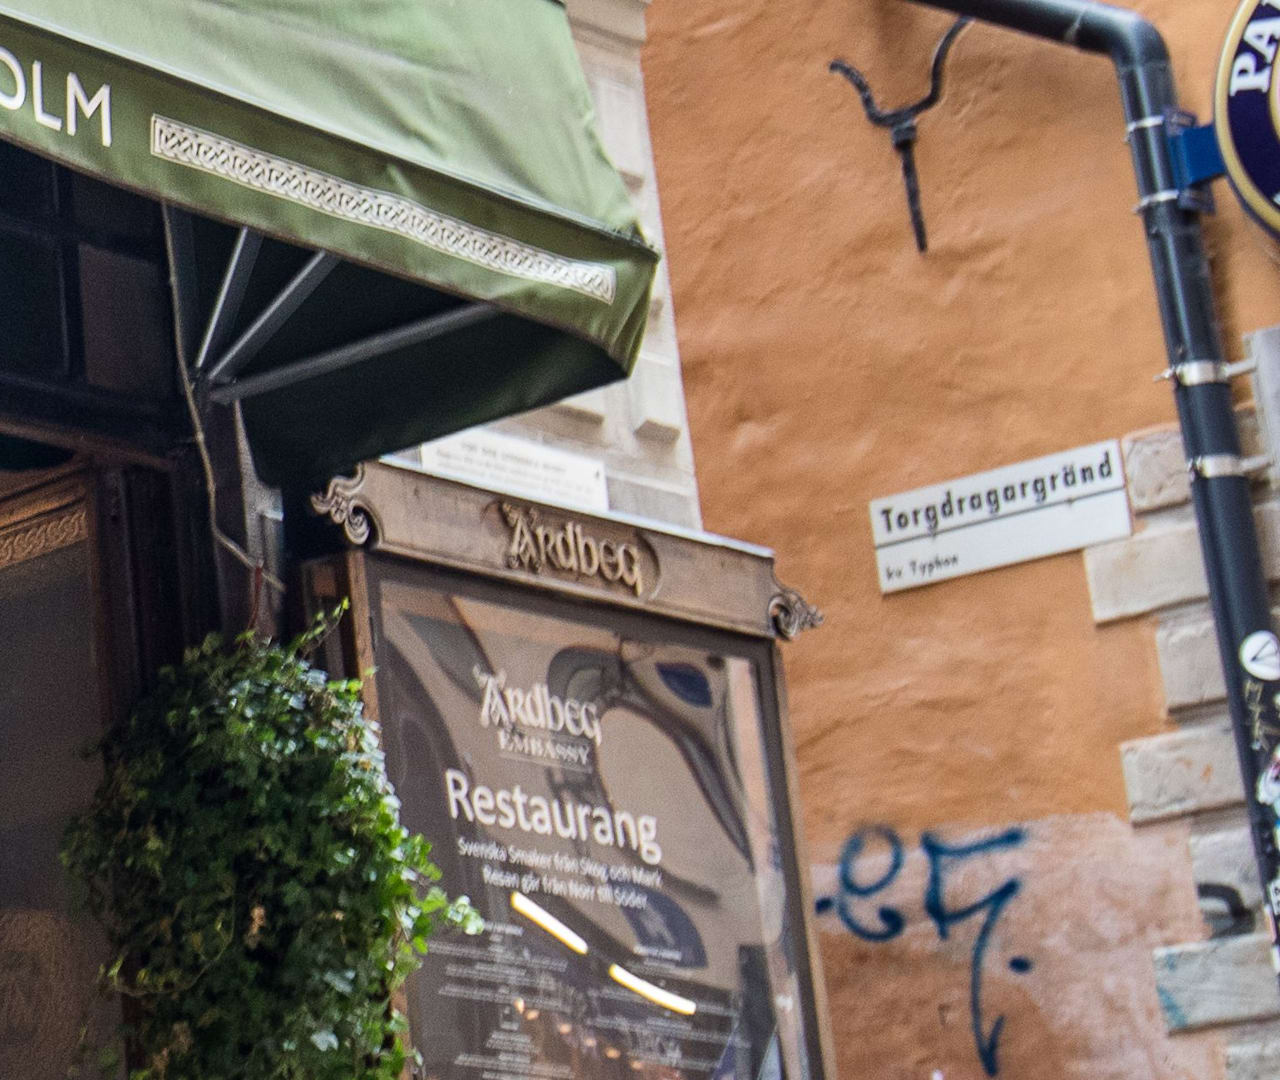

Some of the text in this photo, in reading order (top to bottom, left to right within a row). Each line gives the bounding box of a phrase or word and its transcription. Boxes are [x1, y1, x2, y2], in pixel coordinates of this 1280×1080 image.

[880, 451, 1113, 538] Torgdragargränd
[499, 500, 644, 597] Ardbeg
[472, 663, 602, 746] Ardbeg
[445, 767, 663, 866] Restaurang
